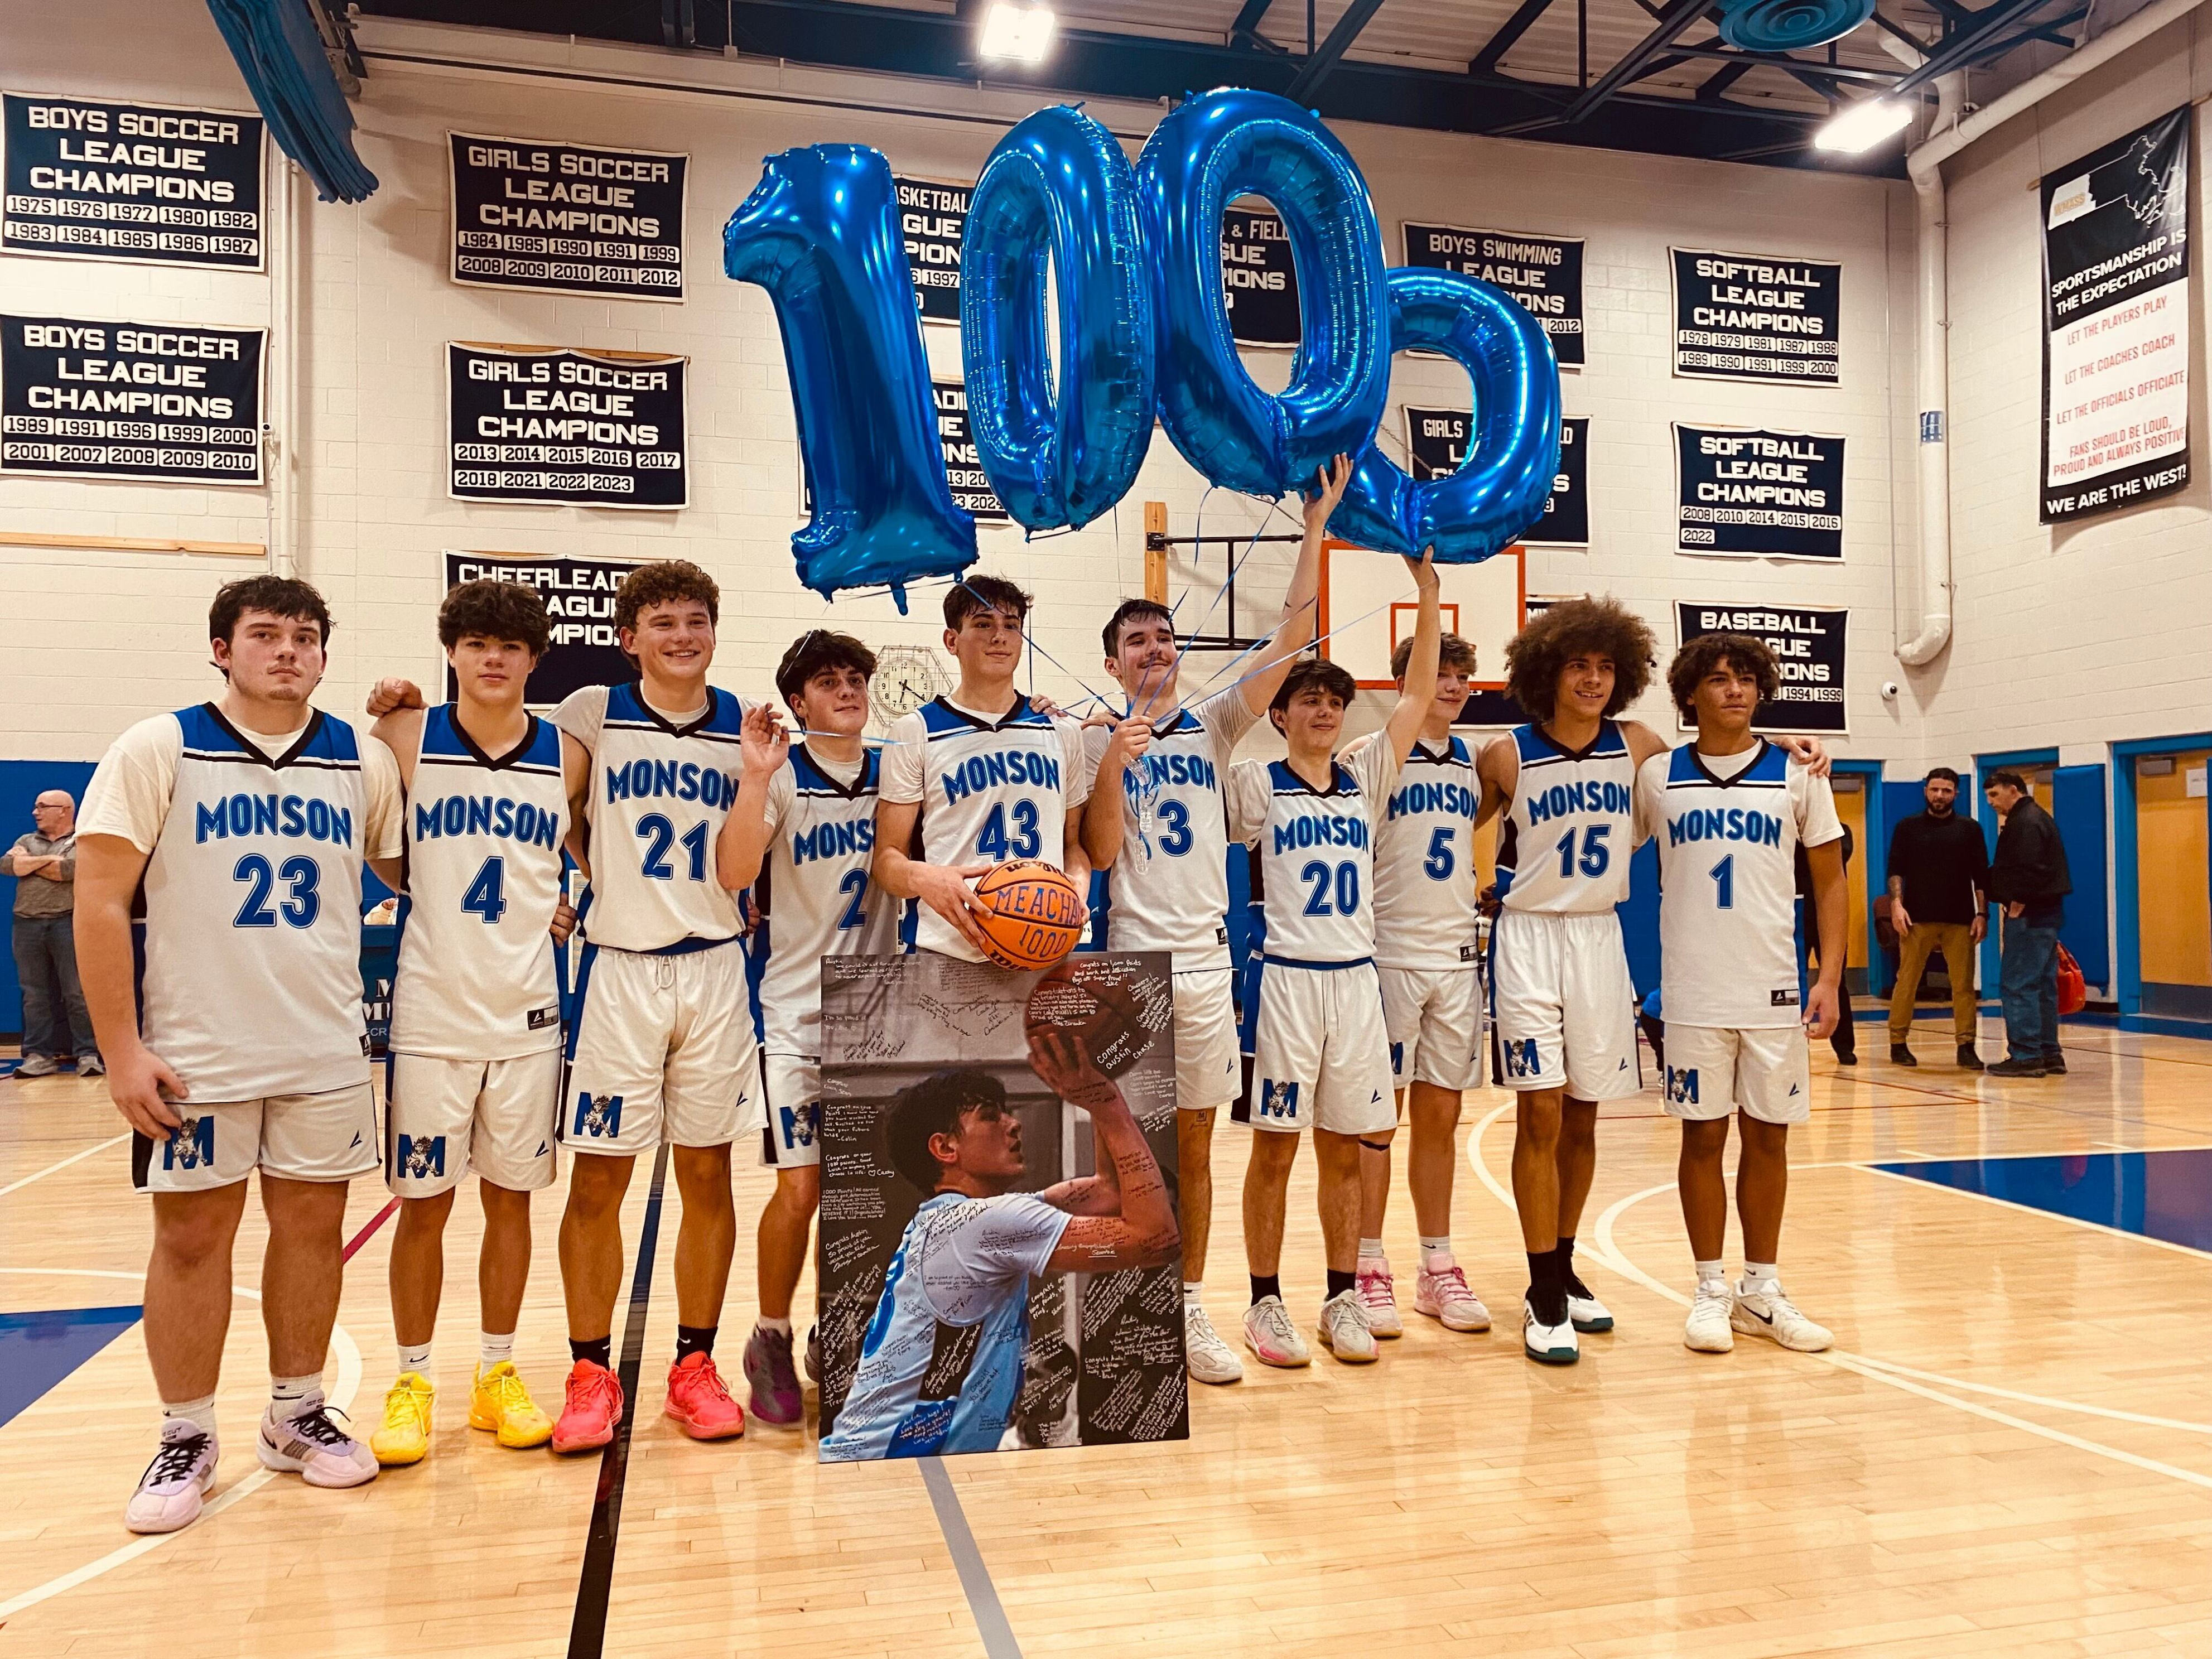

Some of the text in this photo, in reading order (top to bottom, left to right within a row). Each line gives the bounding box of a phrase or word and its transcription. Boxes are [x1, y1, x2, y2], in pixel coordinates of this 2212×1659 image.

[28, 106, 239, 144] BOYS SOCCER
[60, 138, 205, 171] LEAGUE
[469, 146, 668, 182] GIRLS SOCCER
[30, 167, 234, 202] CHAMPIONS
[505, 177, 634, 208] LEAGUE
[11, 197, 253, 229] 1975 1976 1977 1980 1982
[480, 204, 659, 238] CHAMPIONS
[11, 224, 252, 254] 1983 1984 1985 1986 1987
[463, 233, 676, 261] 1984 1985 1990 1991 1999
[1231, 224, 1242, 237] &
[1429, 234, 1562, 266] BOYS SWIMMING
[2051, 229, 2186, 297] SPORTSMANSHIP IS
[462, 258, 677, 285] 2008 2009 2010 2011 2012
[927, 272, 958, 286] 1997
[1696, 259, 1820, 287] SOFTBALL
[2056, 252, 2182, 315] THE EXPECTATION
[1712, 284, 1805, 310] LEAGUE
[1550, 320, 1579, 332] 2012
[1694, 307, 1823, 334] CHAMPIONS
[2068, 296, 2167, 345] LET THE PLAYERS PLAY
[24, 325, 239, 360] BOYS SOCCER
[1683, 332, 1708, 344] 1978
[1715, 335, 1741, 346] 1979
[1748, 337, 1771, 349] 1981
[1780, 340, 1804, 351] 1987
[58, 357, 206, 388] LEAGUE
[469, 359, 667, 390] GIRLS SOCCER
[1683, 353, 1836, 374] 1989 1990 1991 1999 2000
[2065, 334, 2175, 384] LET THE COACHES COACH
[28, 386, 233, 419] CHAMPIONS
[504, 390, 633, 416] LEAGUE
[2057, 370, 2184, 424] LET THE OFFICIALS OFFICIATE
[8, 417, 253, 444] 1989 1991 1996 1999 2000
[478, 416, 658, 445] CHAMPIONS
[1423, 419, 1463, 438] GIRLS
[2070, 416, 2171, 458] FANS SHOULD BE LOUD,
[9, 445, 252, 469] 2001 2007 2008 2009 2010
[458, 446, 676, 467] 2013 2014 2015 2016 2017
[1700, 437, 1824, 461] SOFTBALL
[2054, 460, 2085, 476] PROUD
[2088, 452, 2103, 467] AND
[2107, 441, 2141, 462] ALWAYS
[458, 472, 630, 490] 2018 2021 2022 2023
[1716, 461, 1808, 483] LEAGUE
[1698, 483, 1825, 507] CHAMPIONS
[2046, 464, 2186, 514] WE ARE THE WEST!
[1684, 508, 1838, 528] 2008 2010 2014 2015 2016
[1684, 530, 1712, 542] 2022
[1701, 612, 1826, 634] BASEBALL
[1786, 688, 1810, 700] 1994
[608, 760, 739, 812] MONSON
[942, 751, 1060, 806] MONSON
[1388, 783, 1479, 821] MONSON
[1528, 781, 1630, 827] MONSON
[196, 794, 351, 849] MONSON
[416, 795, 559, 851] MONSON
[976, 799, 1042, 862] 43
[1157, 799, 1193, 857] 3
[1274, 815, 1369, 856] MONSON
[1668, 809, 1782, 849] MONSON
[635, 813, 709, 882] 21
[795, 818, 876, 865] MONS
[1424, 827, 1456, 881] 5
[1556, 824, 1611, 878] 15
[233, 853, 320, 928] 23
[461, 856, 505, 923] 4
[1301, 860, 1359, 917] 20
[1709, 854, 1733, 909] 1
[838, 867, 869, 931] 2
[1019, 924, 1067, 957] 1000
[1097, 1031, 1130, 1064] Congrats
